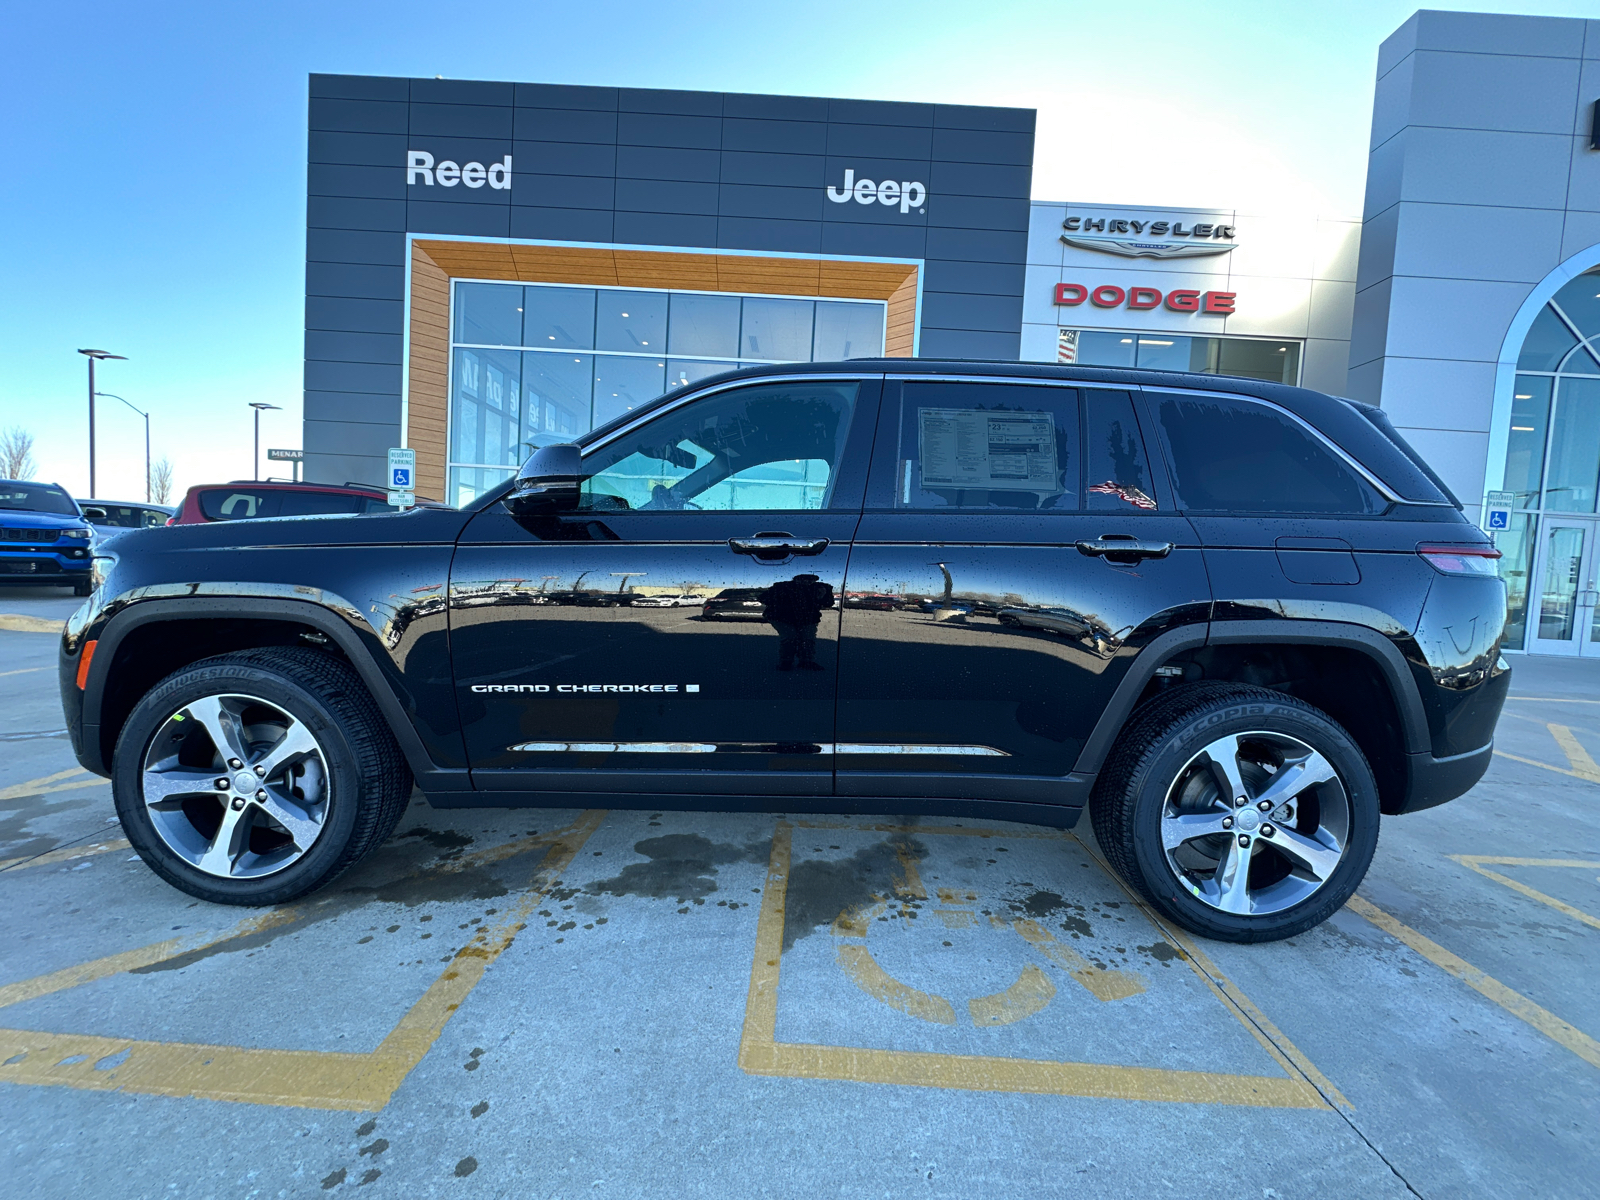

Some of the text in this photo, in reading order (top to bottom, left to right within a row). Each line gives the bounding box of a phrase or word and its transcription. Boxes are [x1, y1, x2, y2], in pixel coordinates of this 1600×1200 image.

[407, 150, 512, 190] Reed
[827, 169, 926, 214] Jeep
[1062, 216, 1236, 239] CHRYSLER
[1054, 282, 1237, 315] DODGE
[271, 450, 303, 458] MENAR
[155, 667, 259, 698] BRIDGESTONE
[471, 684, 679, 693] GRAND CHEROKEE
